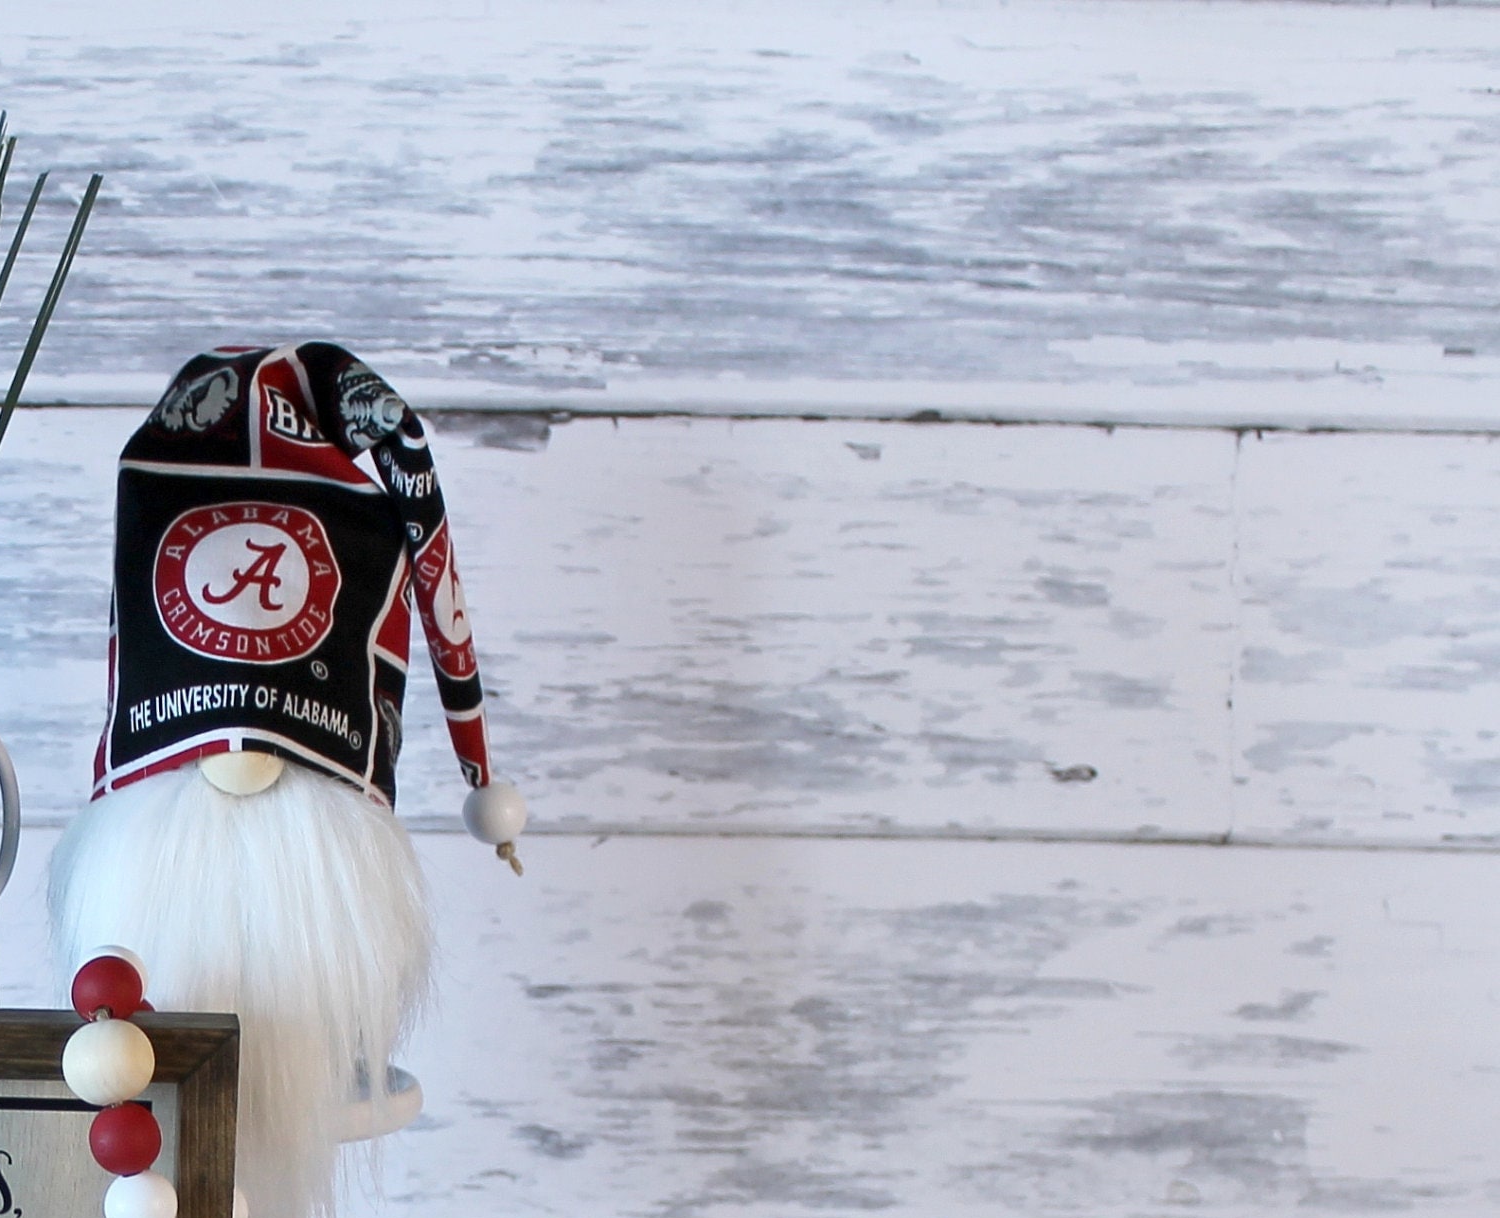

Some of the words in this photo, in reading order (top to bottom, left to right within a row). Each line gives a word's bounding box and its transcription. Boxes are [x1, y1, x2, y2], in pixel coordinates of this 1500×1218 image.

[165, 507, 332, 577] ALABAMA
[163, 588, 271, 656] CRIMSON
[277, 602, 327, 652] TIDE
[130, 699, 152, 733] THE
[156, 684, 249, 722] UNIVERSITY
[255, 686, 278, 709] OF
